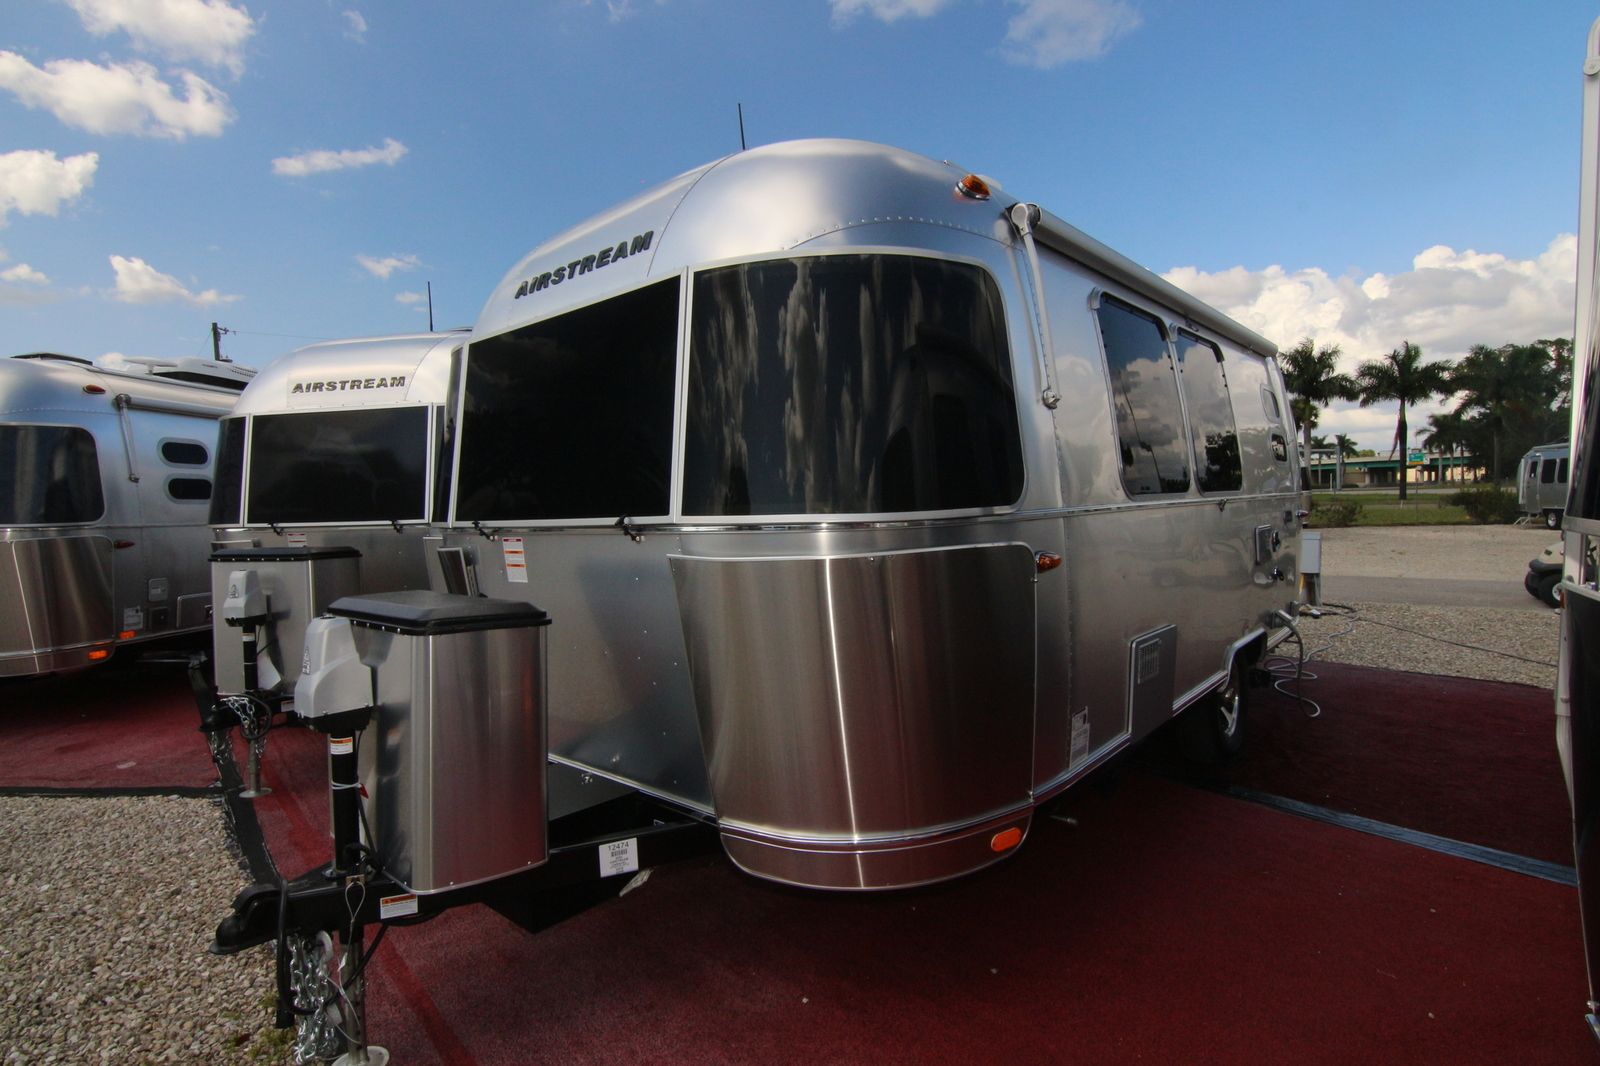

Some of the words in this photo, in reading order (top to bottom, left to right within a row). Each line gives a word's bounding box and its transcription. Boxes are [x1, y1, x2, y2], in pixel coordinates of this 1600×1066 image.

[514, 230, 654, 299] AIRSTREAM
[292, 376, 406, 394] AIRSTREAM
[608, 841, 630, 851] 12474
